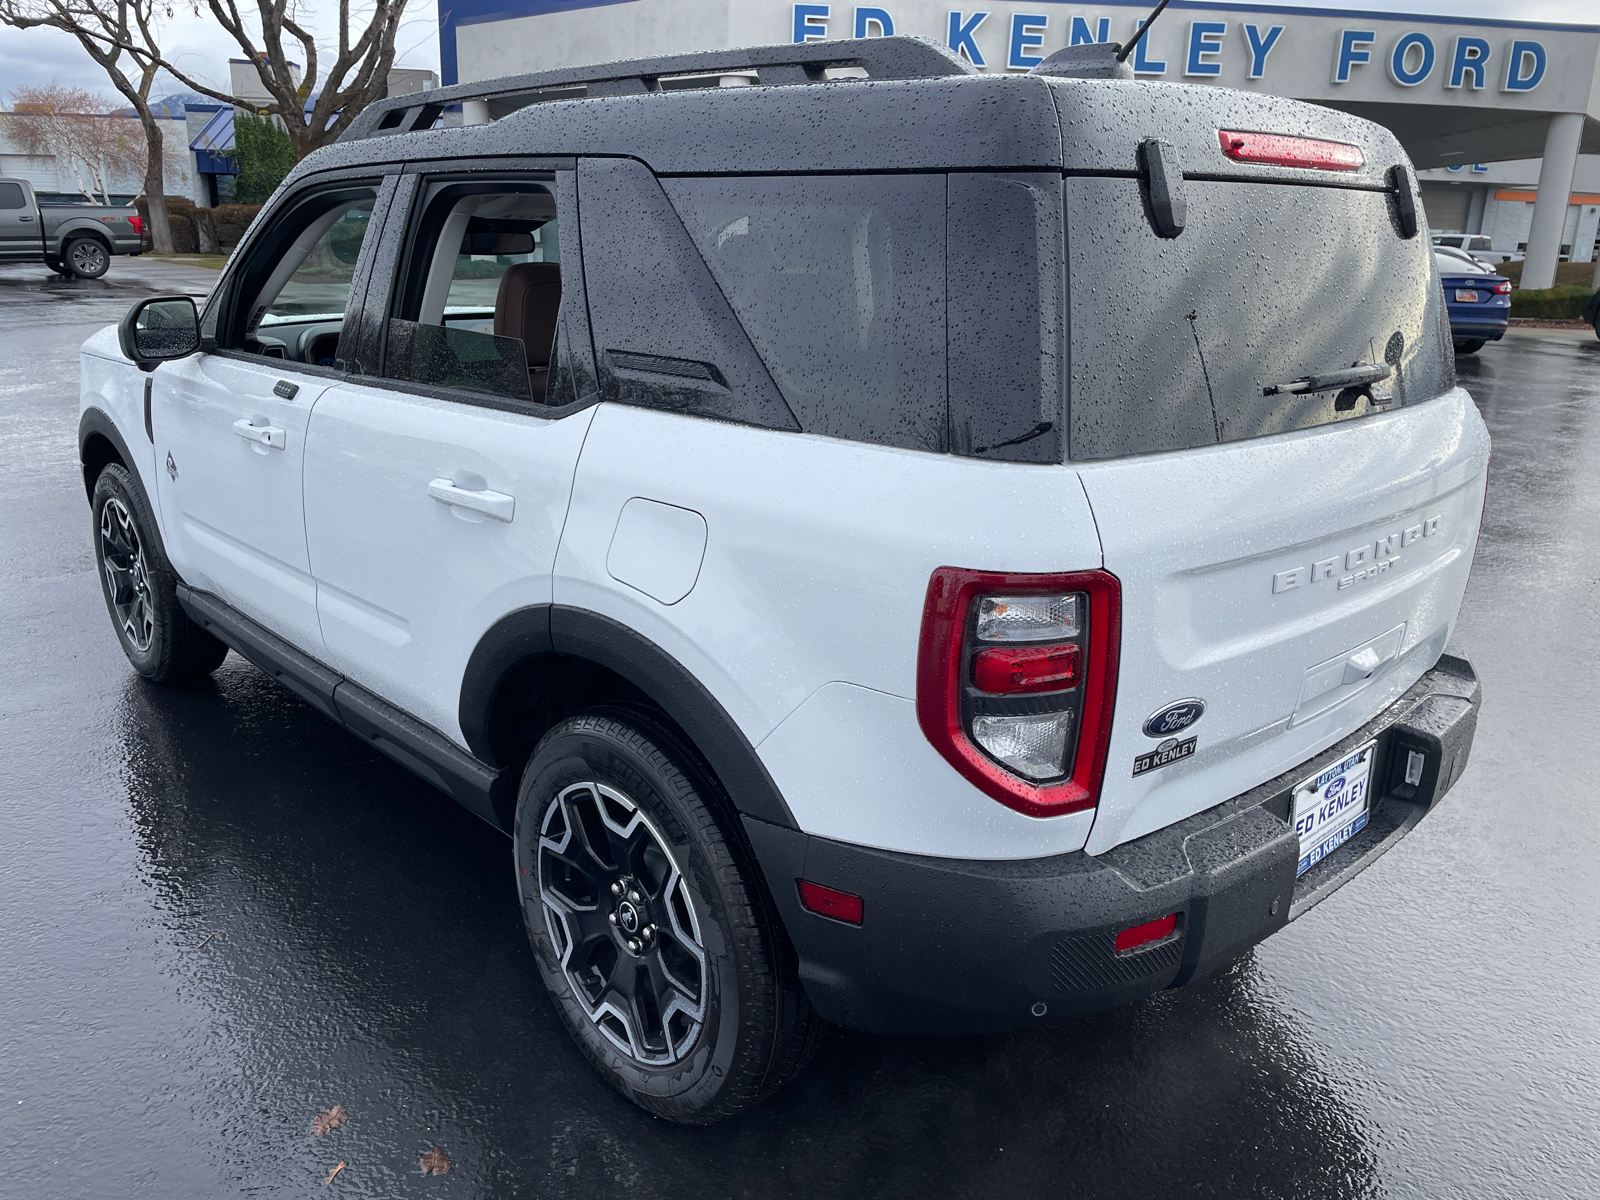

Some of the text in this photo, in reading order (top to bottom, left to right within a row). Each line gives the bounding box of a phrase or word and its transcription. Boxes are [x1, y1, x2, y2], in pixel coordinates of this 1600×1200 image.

[1330, 28, 1548, 92] FORD
[1271, 514, 1442, 594] BRONCO
[1337, 555, 1401, 590] SPORT
[1160, 707, 1196, 732] Ford
[1133, 741, 1197, 773] ED KENLEY
[1343, 752, 1360, 770] UTAH
[1327, 780, 1344, 797] Ford
[1295, 812, 1315, 838] ED
[1317, 777, 1366, 826] KENLEY
[1310, 846, 1321, 866] ED
[1322, 822, 1354, 856] KENLEY
